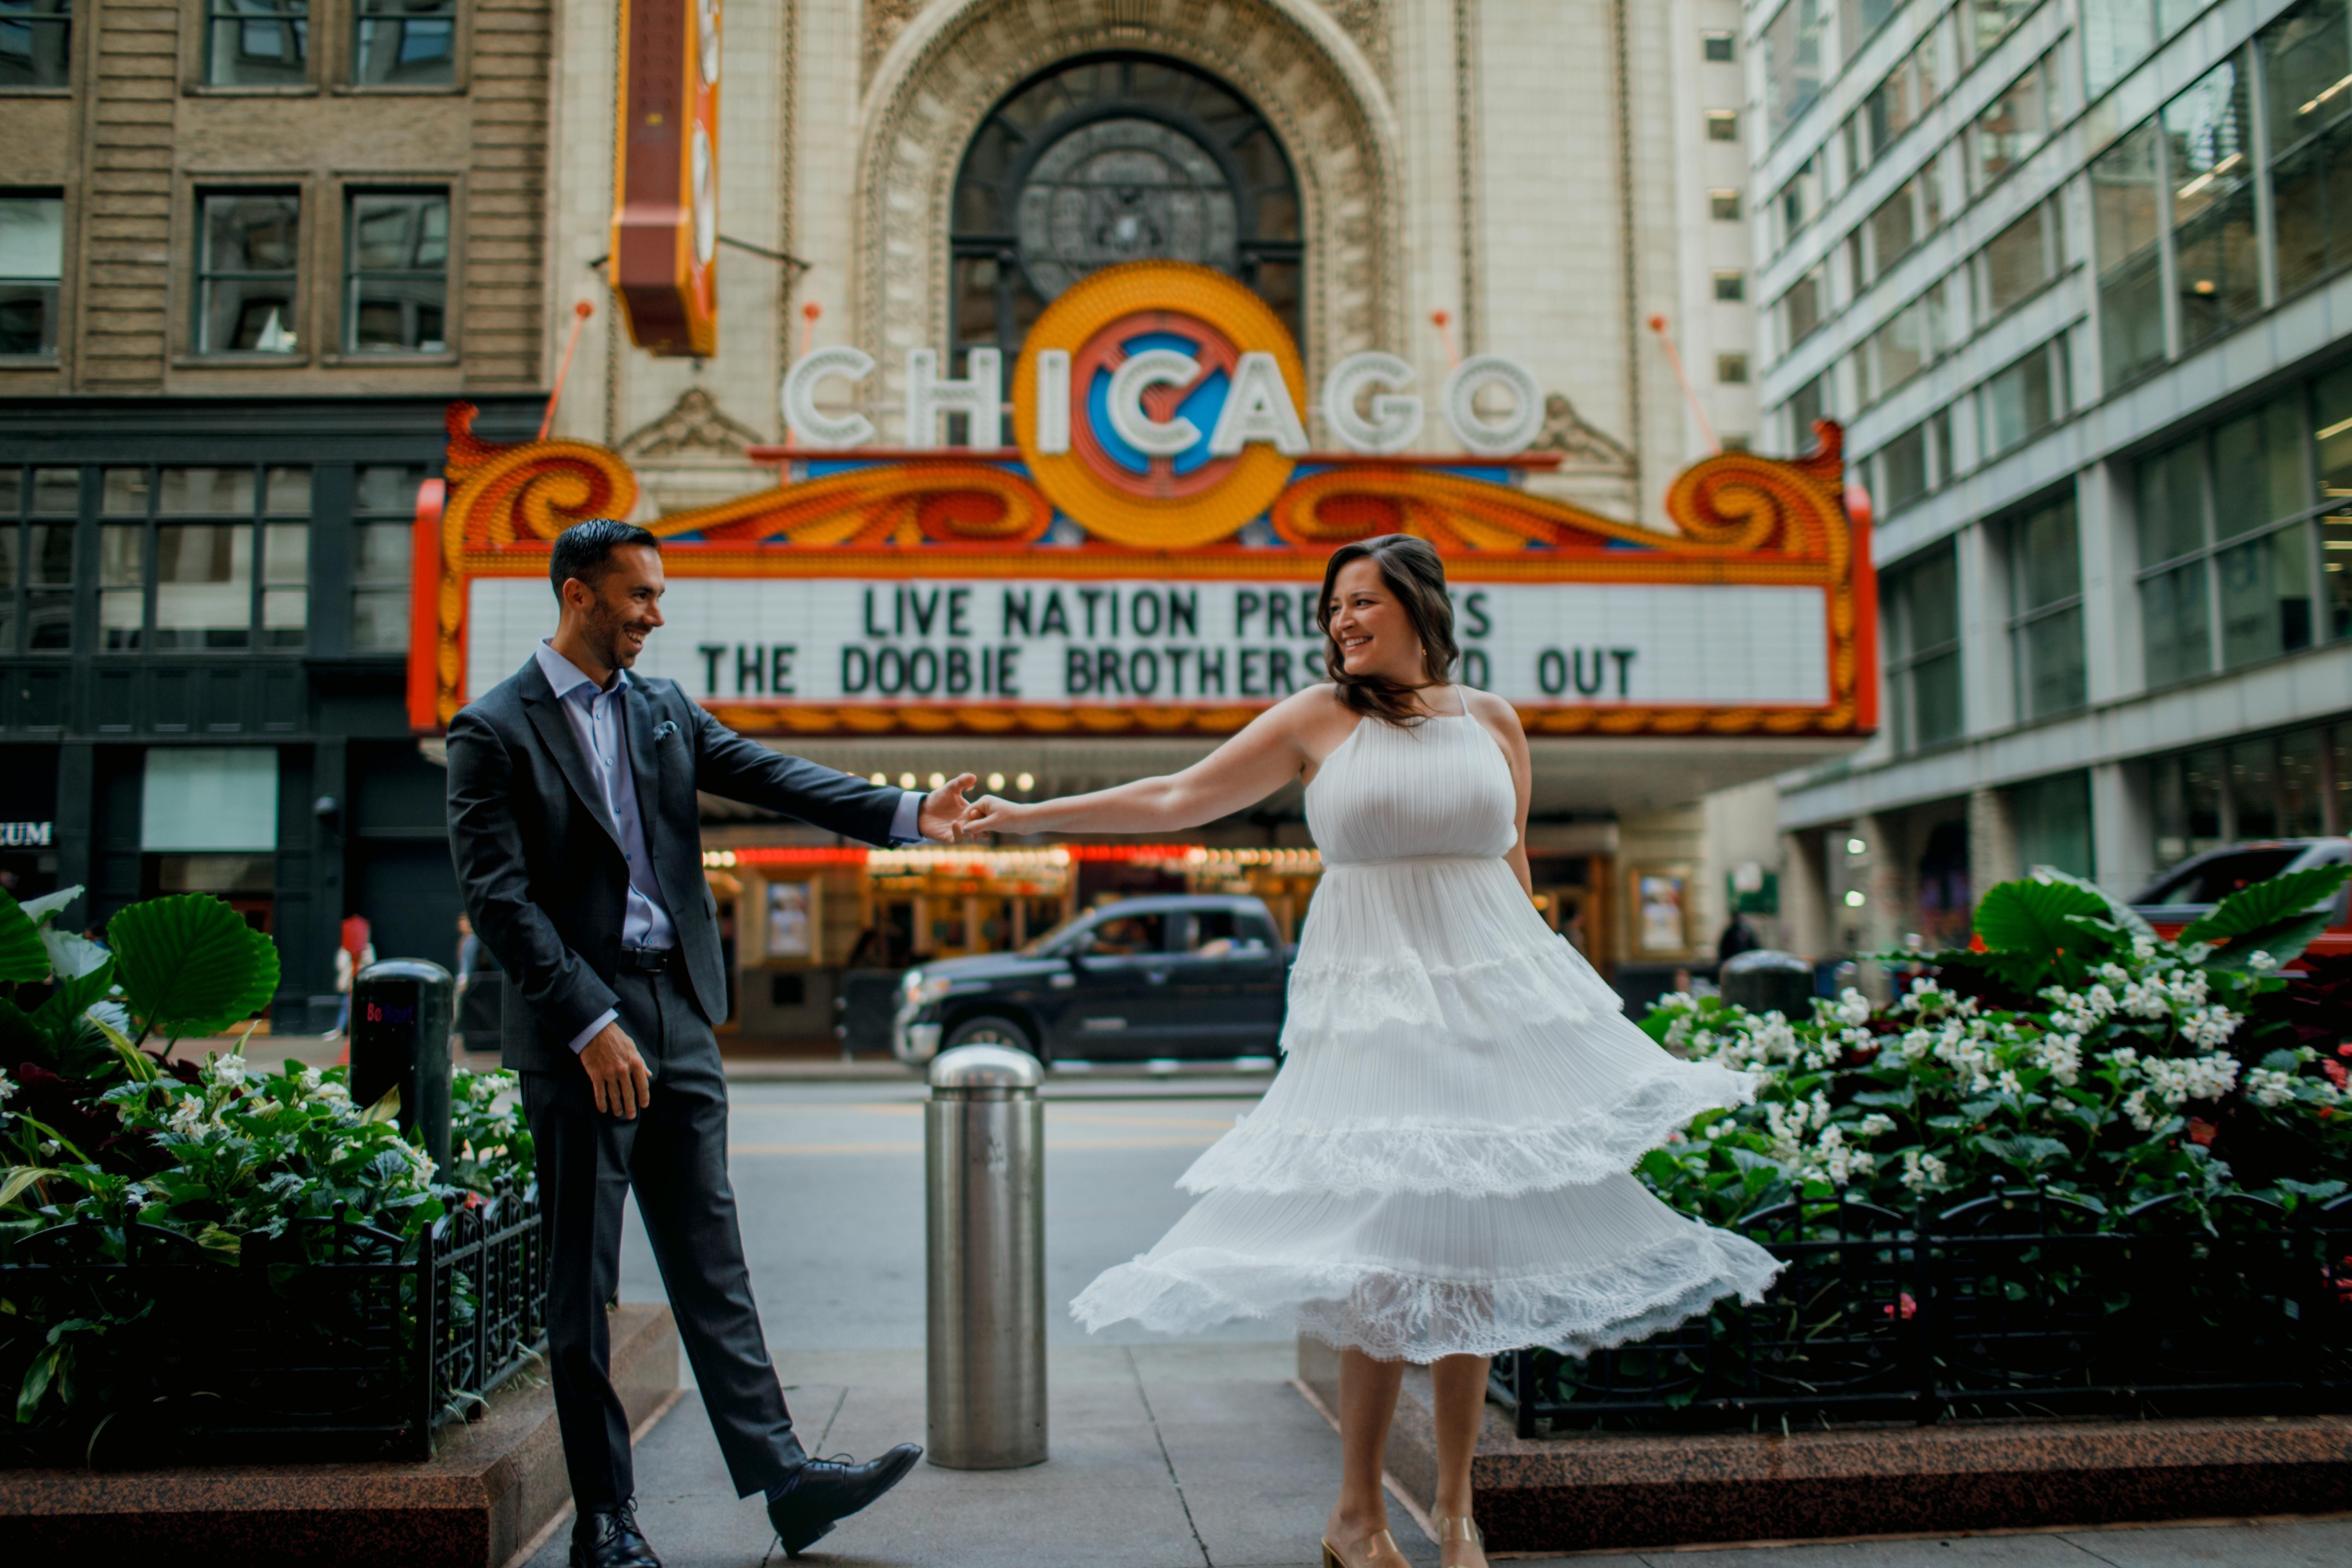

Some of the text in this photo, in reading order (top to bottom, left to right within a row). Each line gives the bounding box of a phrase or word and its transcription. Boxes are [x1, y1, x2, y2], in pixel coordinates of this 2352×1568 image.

[781, 345, 1546, 458] CHICAGO
[864, 587, 972, 638] LIVE
[1002, 588, 1200, 639] NATION
[698, 645, 797, 694] THE
[840, 645, 1021, 695] DOOBIE
[1064, 646, 1329, 697] BROTHERS
[1537, 647, 1638, 697] OUT
